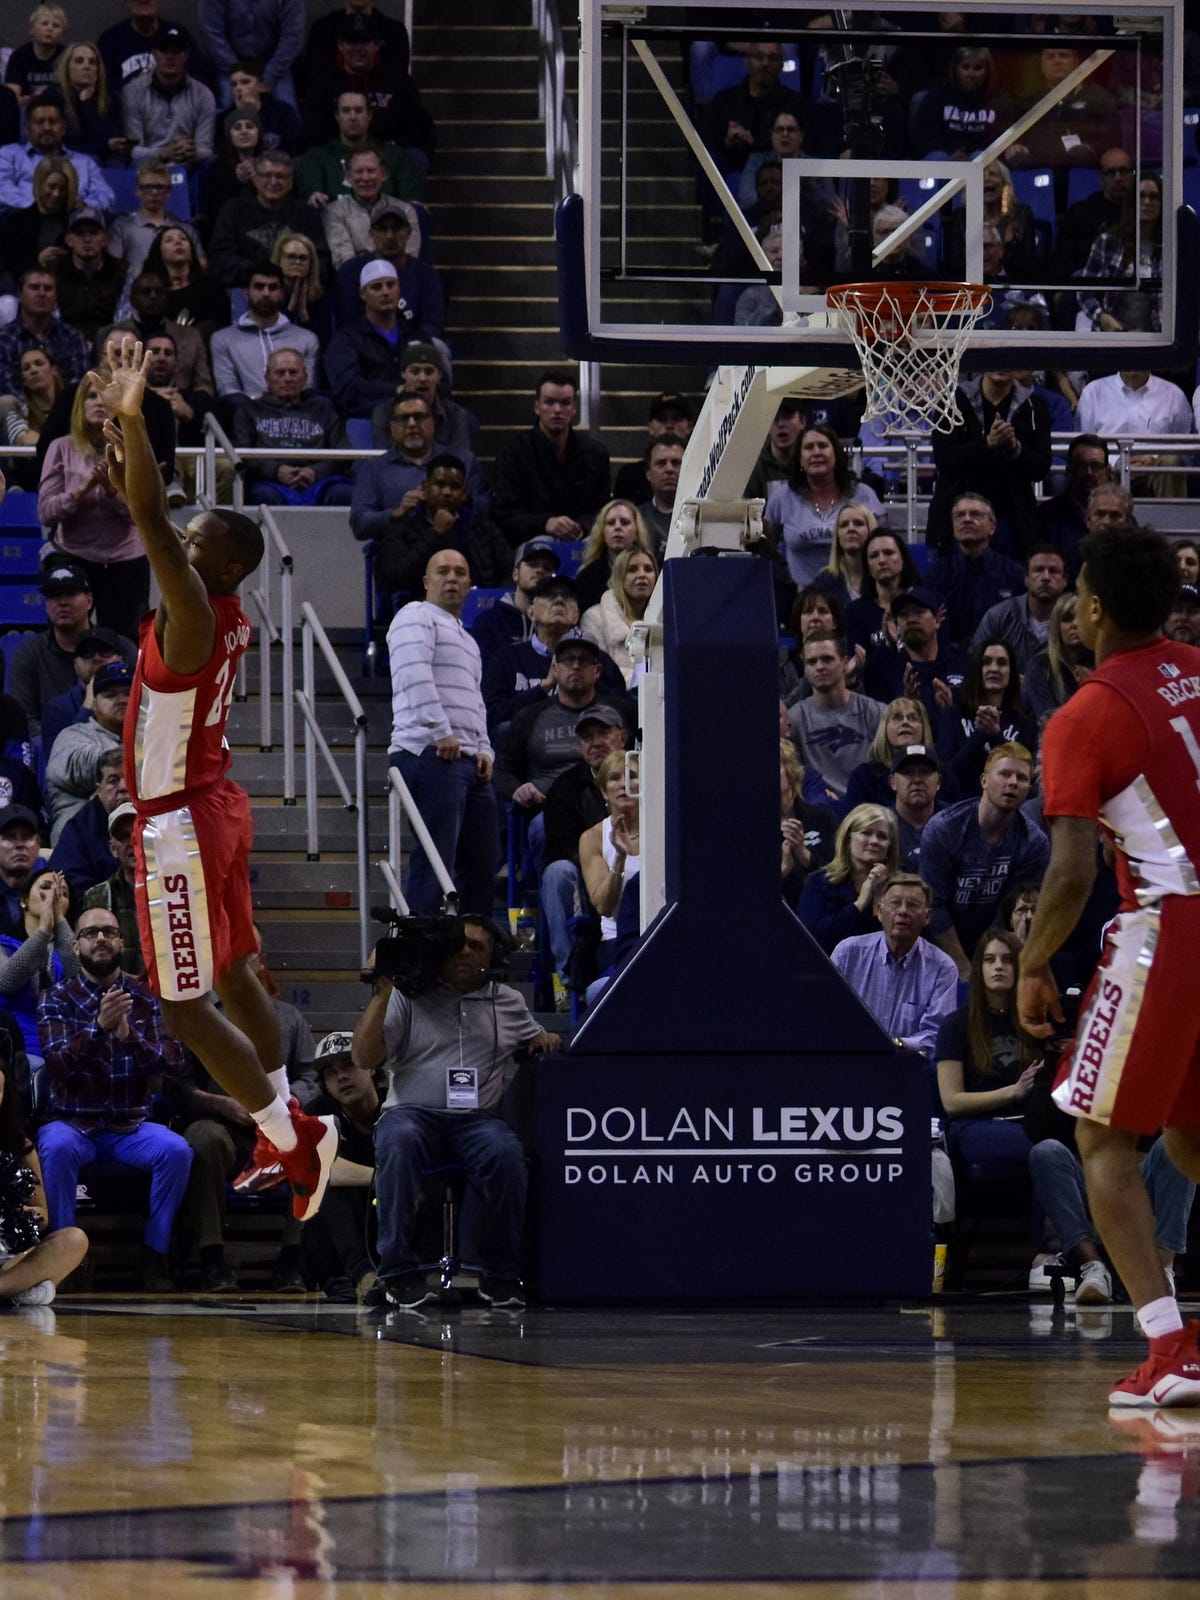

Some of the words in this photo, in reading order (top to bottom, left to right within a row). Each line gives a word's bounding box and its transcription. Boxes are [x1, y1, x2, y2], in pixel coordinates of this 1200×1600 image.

[800, 527, 833, 545] NEVA
[544, 725, 578, 742] NEV
[1168, 714, 1200, 795] 1
[166, 873, 201, 992] REBELS
[1069, 979, 1124, 1115] REBELS
[565, 1106, 734, 1143] DOLAN
[751, 1105, 905, 1142] LEXUS
[564, 1165, 675, 1185] DOLAN
[690, 1164, 777, 1184] AUTO
[793, 1164, 904, 1184] GROUP
